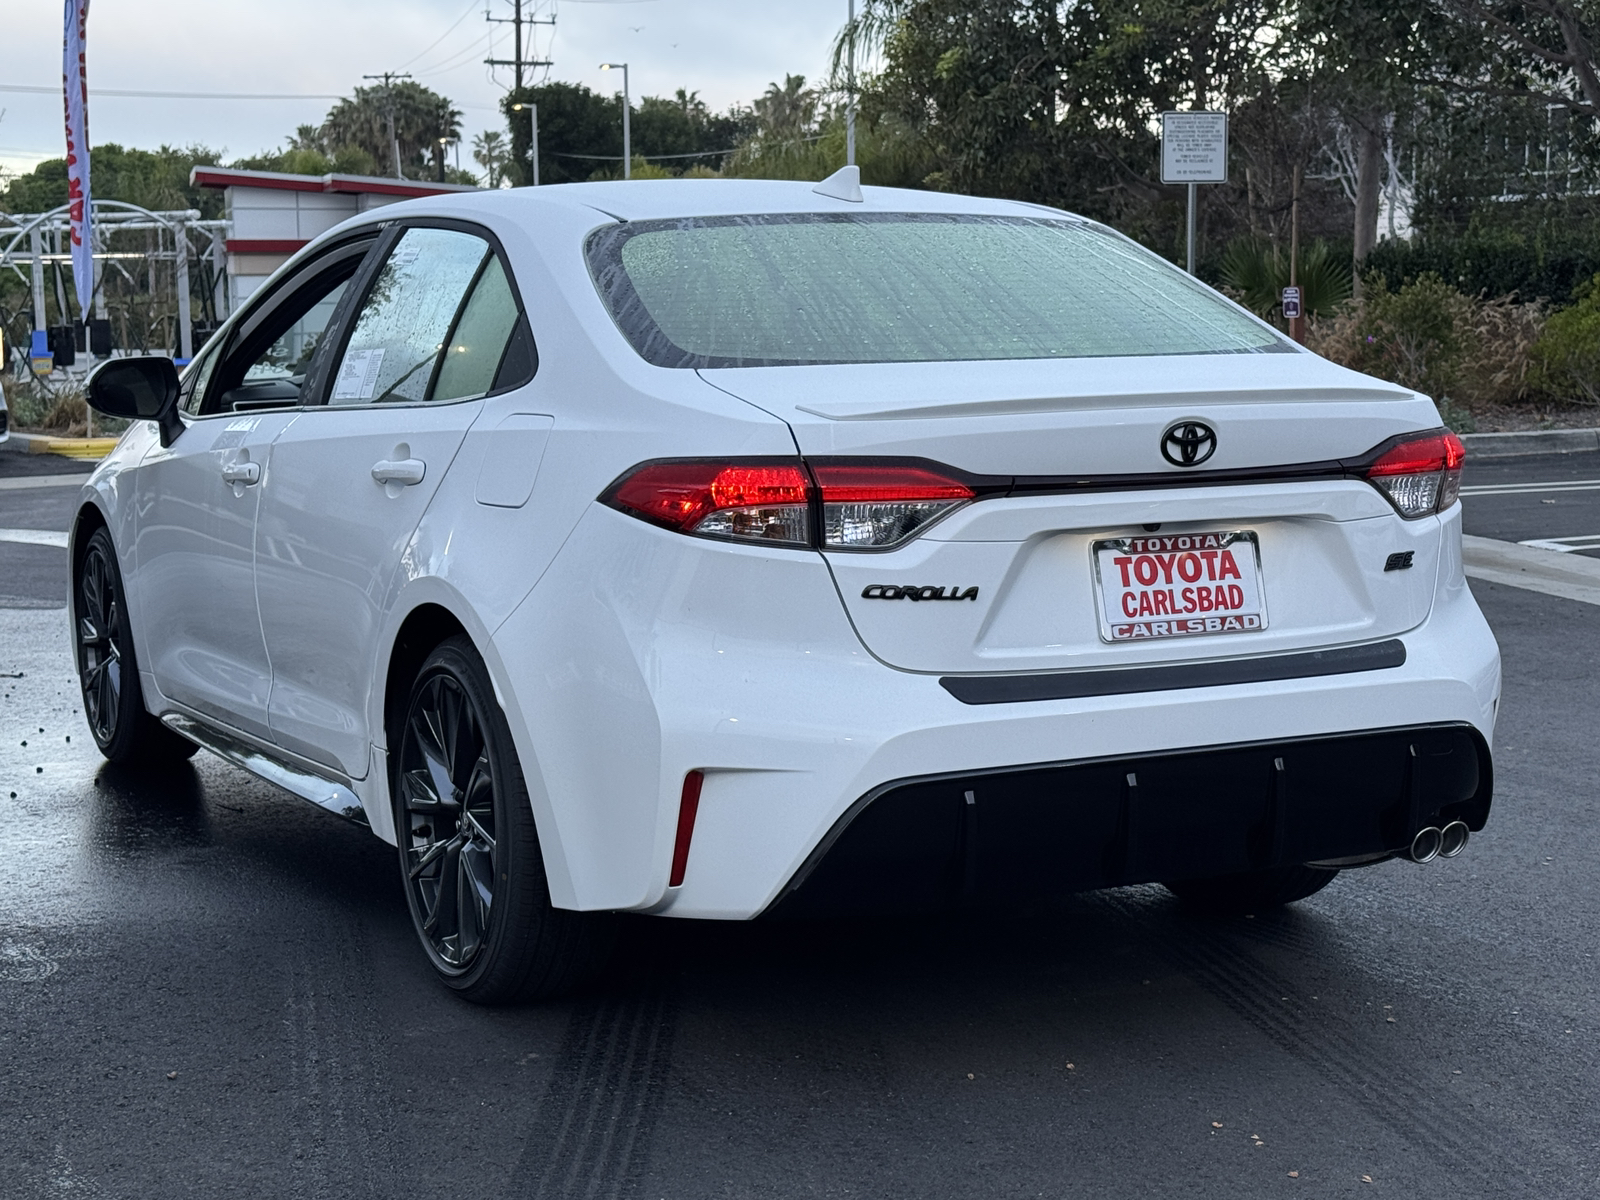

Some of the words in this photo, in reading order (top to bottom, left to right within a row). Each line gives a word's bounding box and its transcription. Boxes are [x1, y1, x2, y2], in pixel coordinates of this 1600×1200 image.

[1134, 535, 1218, 551] TOYOTA
[1113, 550, 1242, 587] TOYOTA
[1384, 550, 1415, 572] SE
[861, 584, 979, 602] COROLLA
[1121, 584, 1244, 618] CARLSBAD
[1112, 614, 1260, 639] CARLSBAD
